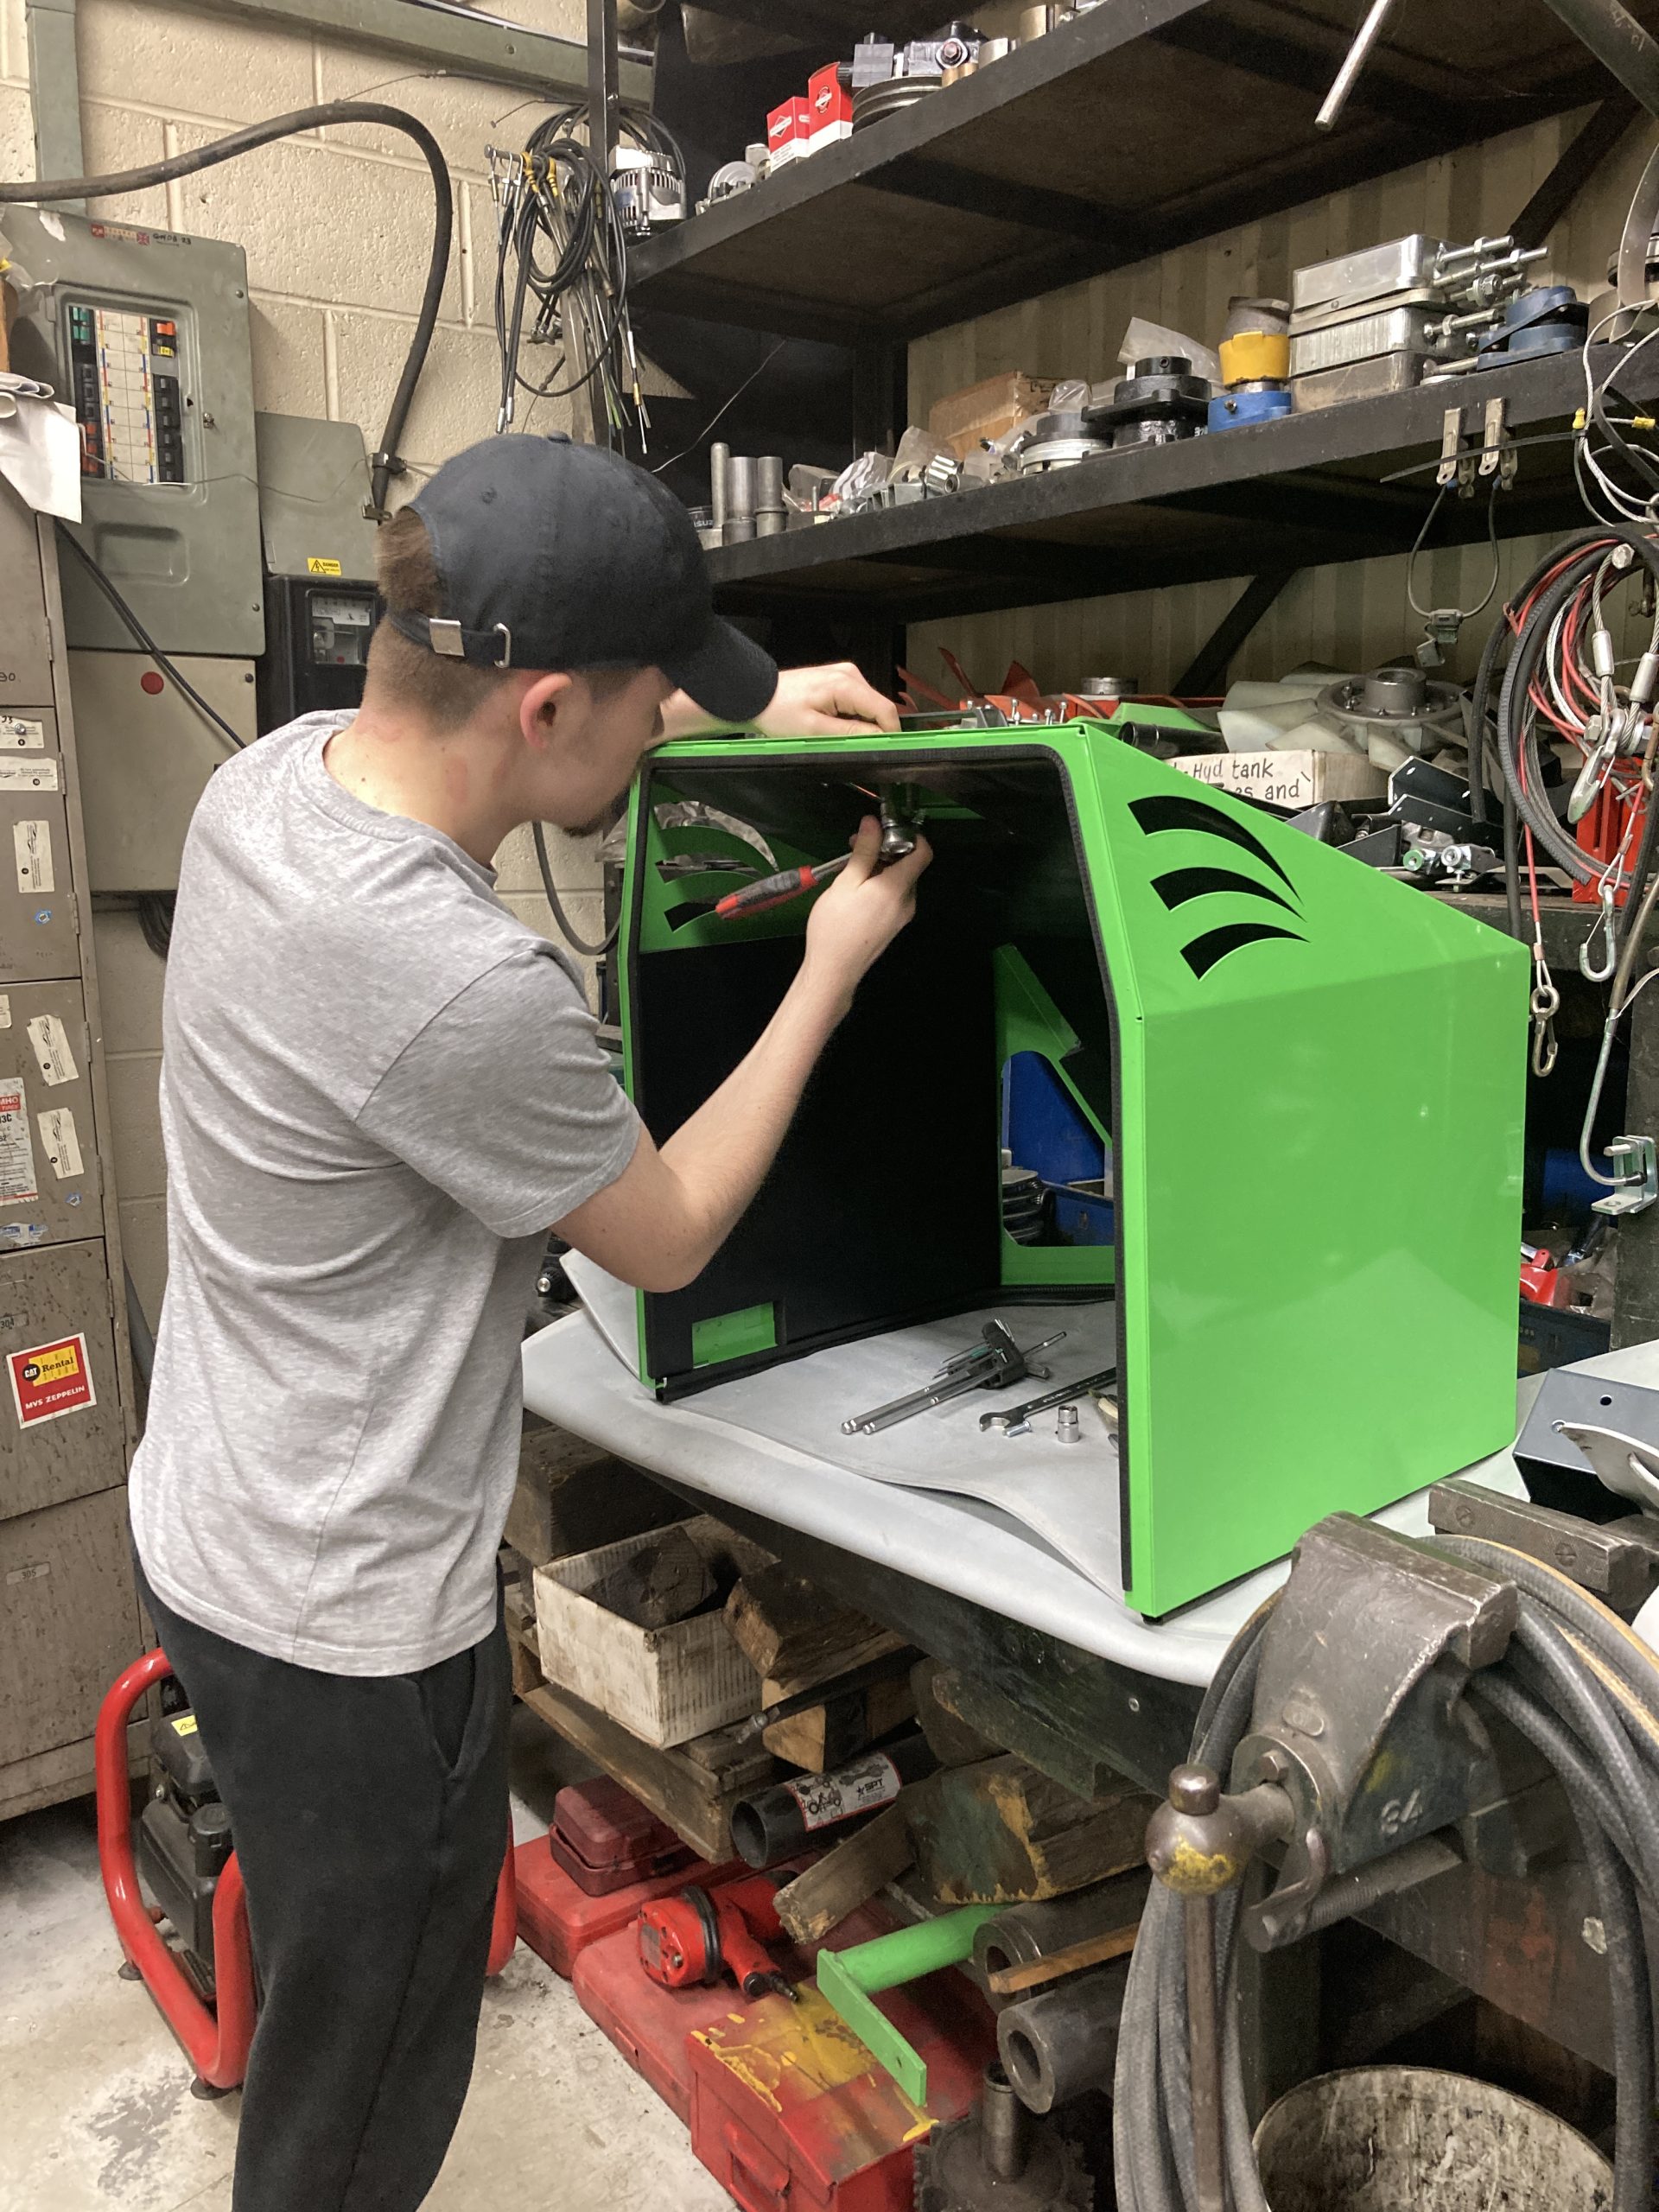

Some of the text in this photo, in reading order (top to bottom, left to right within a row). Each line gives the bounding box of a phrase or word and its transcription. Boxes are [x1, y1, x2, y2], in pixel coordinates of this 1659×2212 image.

[1232, 758, 1274, 779] tank
[1265, 779, 1300, 800] and
[24, 1357, 73, 1378] CAT Rental
[25, 1386, 85, 1409] MVS ZEPPELIN
